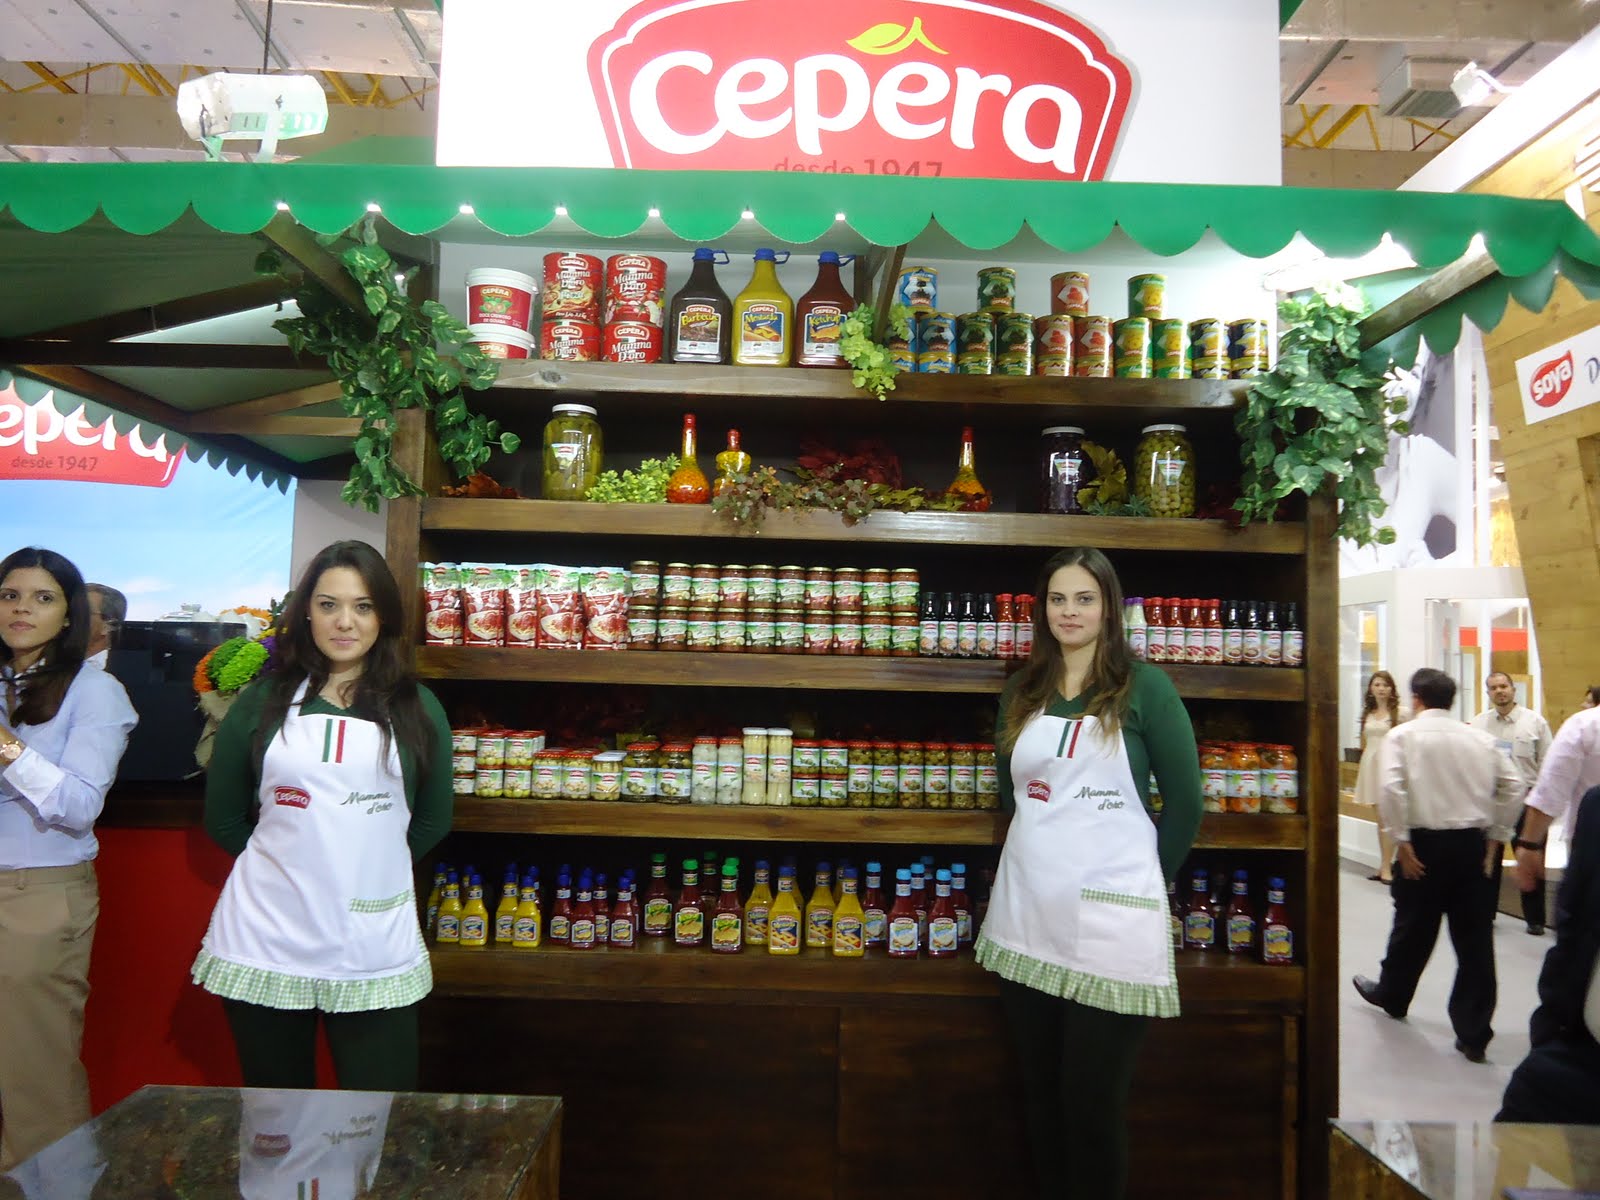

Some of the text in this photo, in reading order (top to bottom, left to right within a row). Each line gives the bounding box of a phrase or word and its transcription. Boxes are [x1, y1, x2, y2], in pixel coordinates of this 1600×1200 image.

[11, 456, 98, 471] desde 1947
[340, 791, 392, 805] Mamma
[1073, 786, 1121, 799] Mamma
